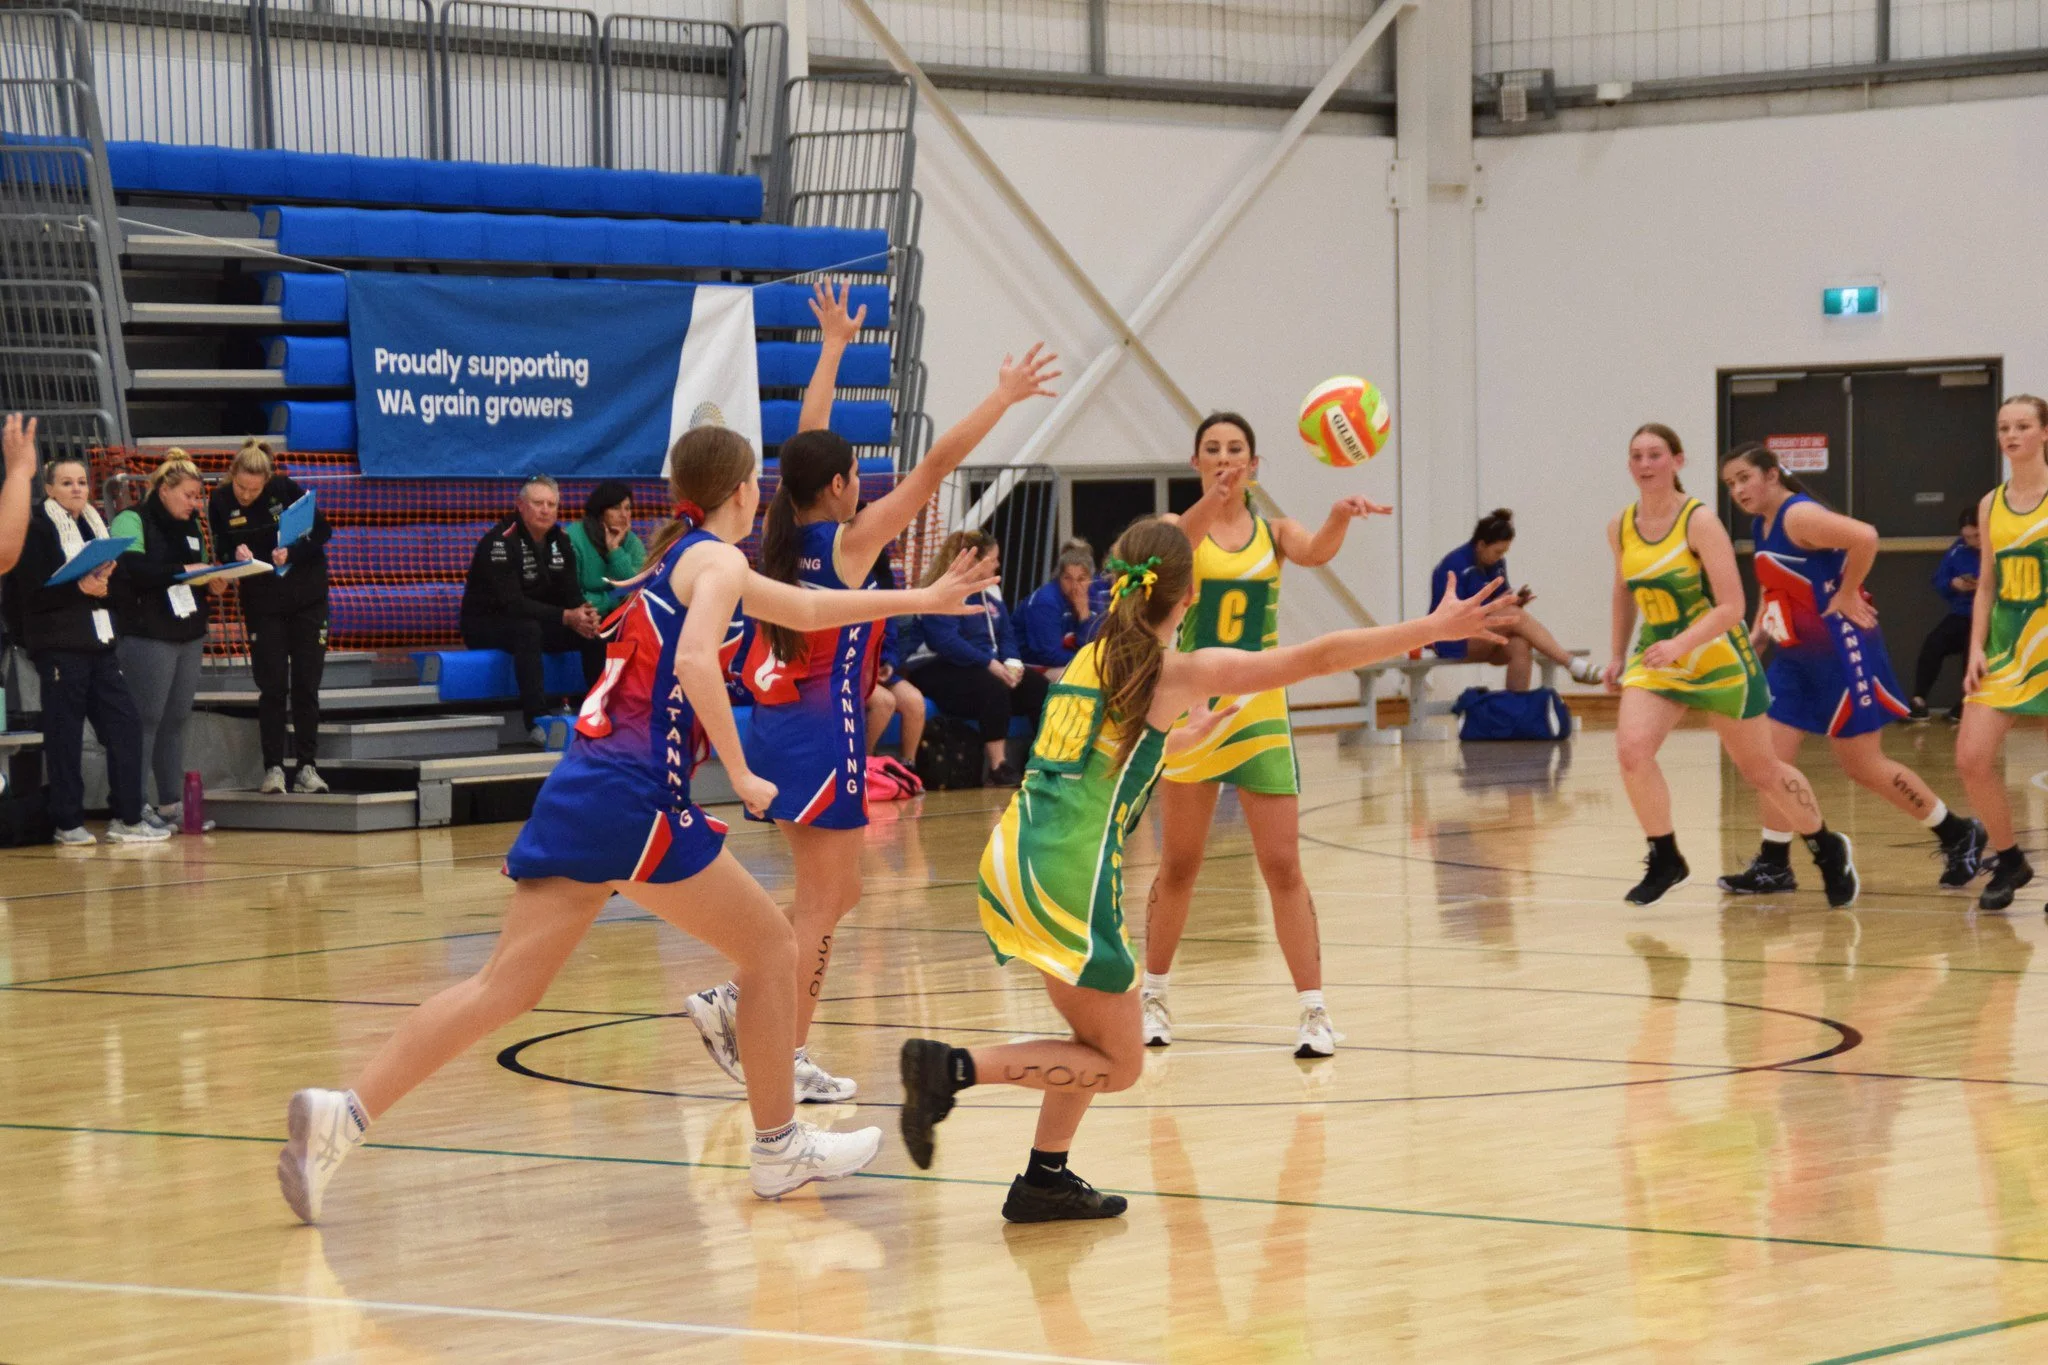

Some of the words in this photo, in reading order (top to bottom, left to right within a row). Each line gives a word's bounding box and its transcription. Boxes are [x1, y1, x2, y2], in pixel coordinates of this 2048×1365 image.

[375, 347, 463, 384] Proudly
[468, 351, 589, 387] supporting
[377, 389, 416, 416] WA
[420, 389, 480, 424] grain
[485, 394, 574, 425] growers
[1216, 589, 1248, 644] C
[808, 935, 832, 998] 520
[1004, 1064, 1110, 1089] 505
